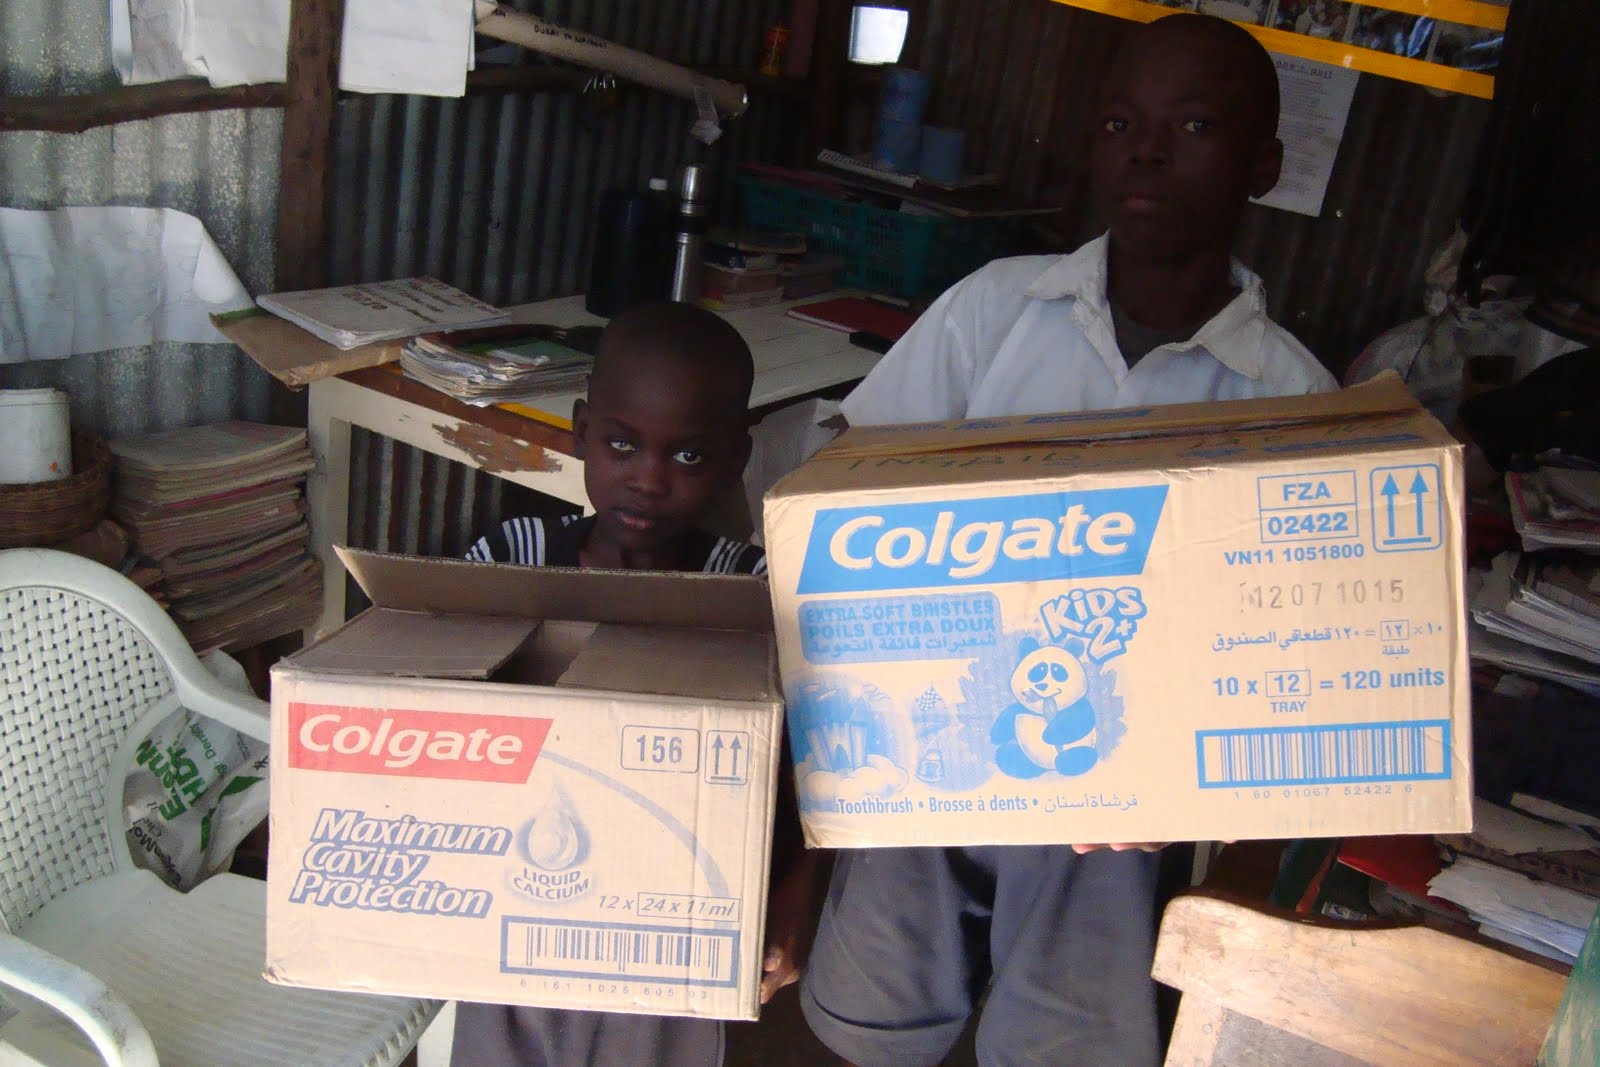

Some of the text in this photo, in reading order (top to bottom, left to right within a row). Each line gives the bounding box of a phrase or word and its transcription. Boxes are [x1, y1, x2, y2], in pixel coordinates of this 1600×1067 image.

[1282, 481, 1331, 501] FZA
[1267, 512, 1349, 536] 02422
[829, 503, 1137, 580] Colgate
[1223, 543, 1365, 566] VN11 1051800
[806, 599, 995, 623] EXTRA SOFT BRISTLES
[808, 617, 996, 638] POILS EXTRA DOUX
[1213, 677, 1240, 696] 10
[1273, 674, 1301, 693] 12
[1341, 670, 1382, 690] 120
[1389, 667, 1446, 688] units
[1270, 701, 1308, 713] TRAY
[299, 714, 524, 768] Colgate
[636, 735, 682, 763] 156
[1253, 790, 1270, 799] 60
[1344, 784, 1392, 795] 52422
[838, 794, 1028, 814] Toothbrush Brosse à dents
[309, 808, 514, 856] Maximum
[302, 841, 431, 886] Cavity
[513, 877, 590, 899] CALCIUM
[522, 868, 581, 885] LIQUID
[288, 869, 494, 919] Protection
[599, 896, 620, 909] 12
[641, 898, 664, 912] 24
